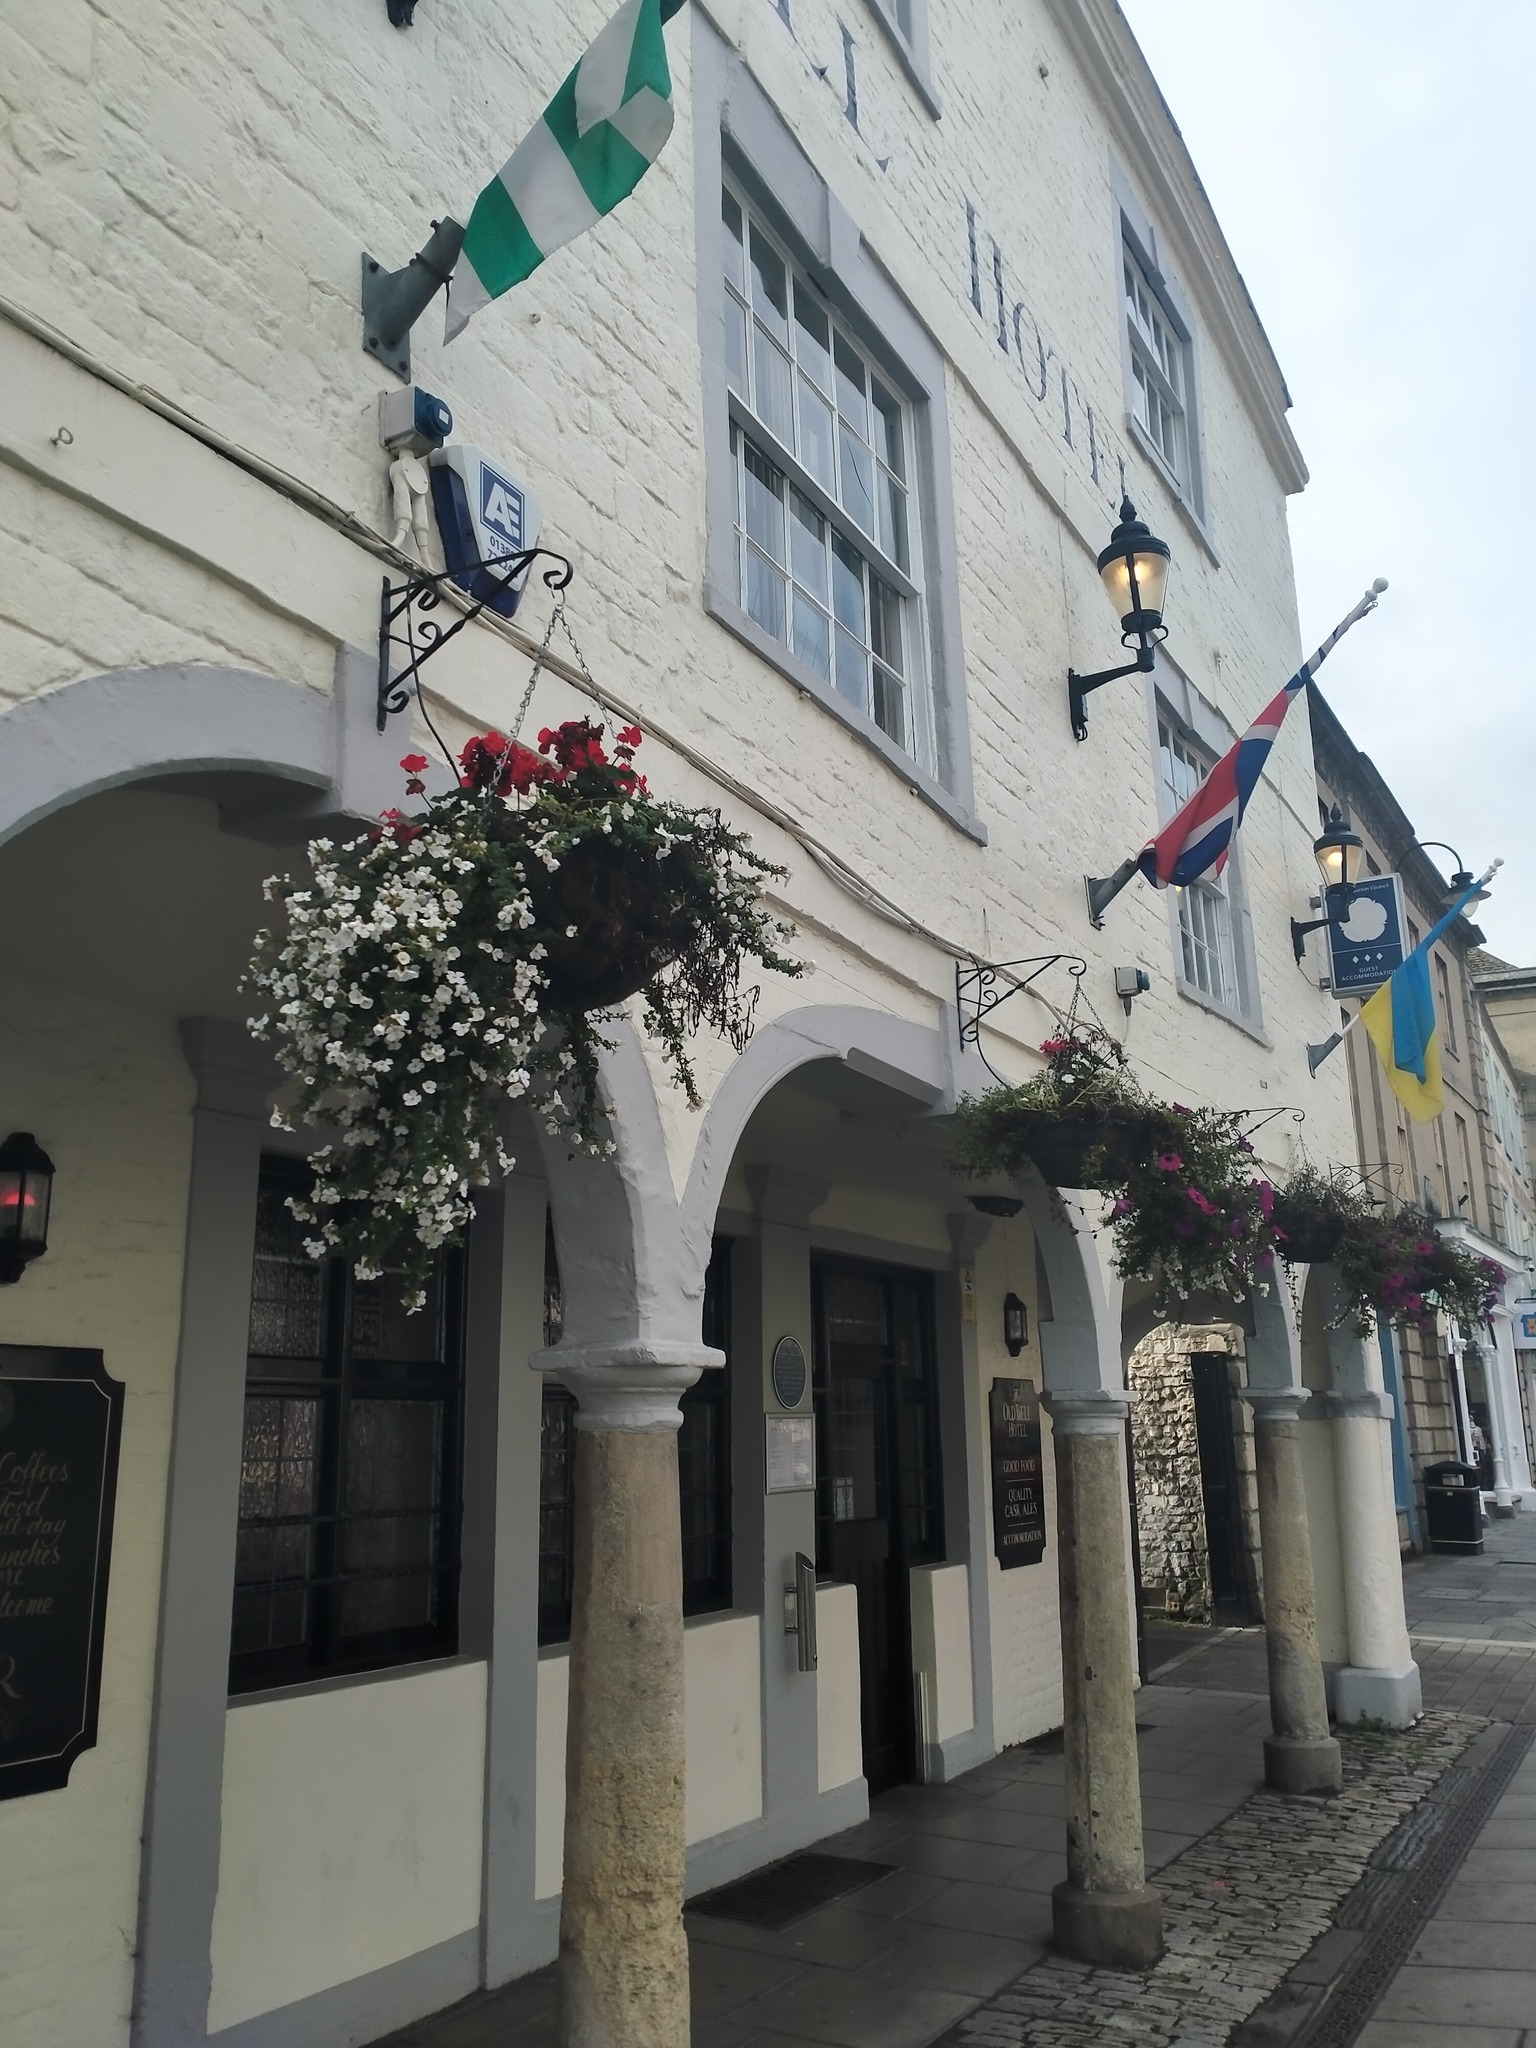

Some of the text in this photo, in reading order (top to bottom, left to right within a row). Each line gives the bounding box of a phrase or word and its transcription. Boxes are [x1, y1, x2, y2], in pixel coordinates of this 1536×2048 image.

[1370, 882, 1391, 891] Council
[1358, 965, 1379, 973] GUEST
[1003, 1459, 1035, 1473] GOOD FOOD
[1008, 1487, 1032, 1503] QUALITY
[1004, 1501, 1037, 1518] CASK ALES
[26, 1514, 66, 1549] day
